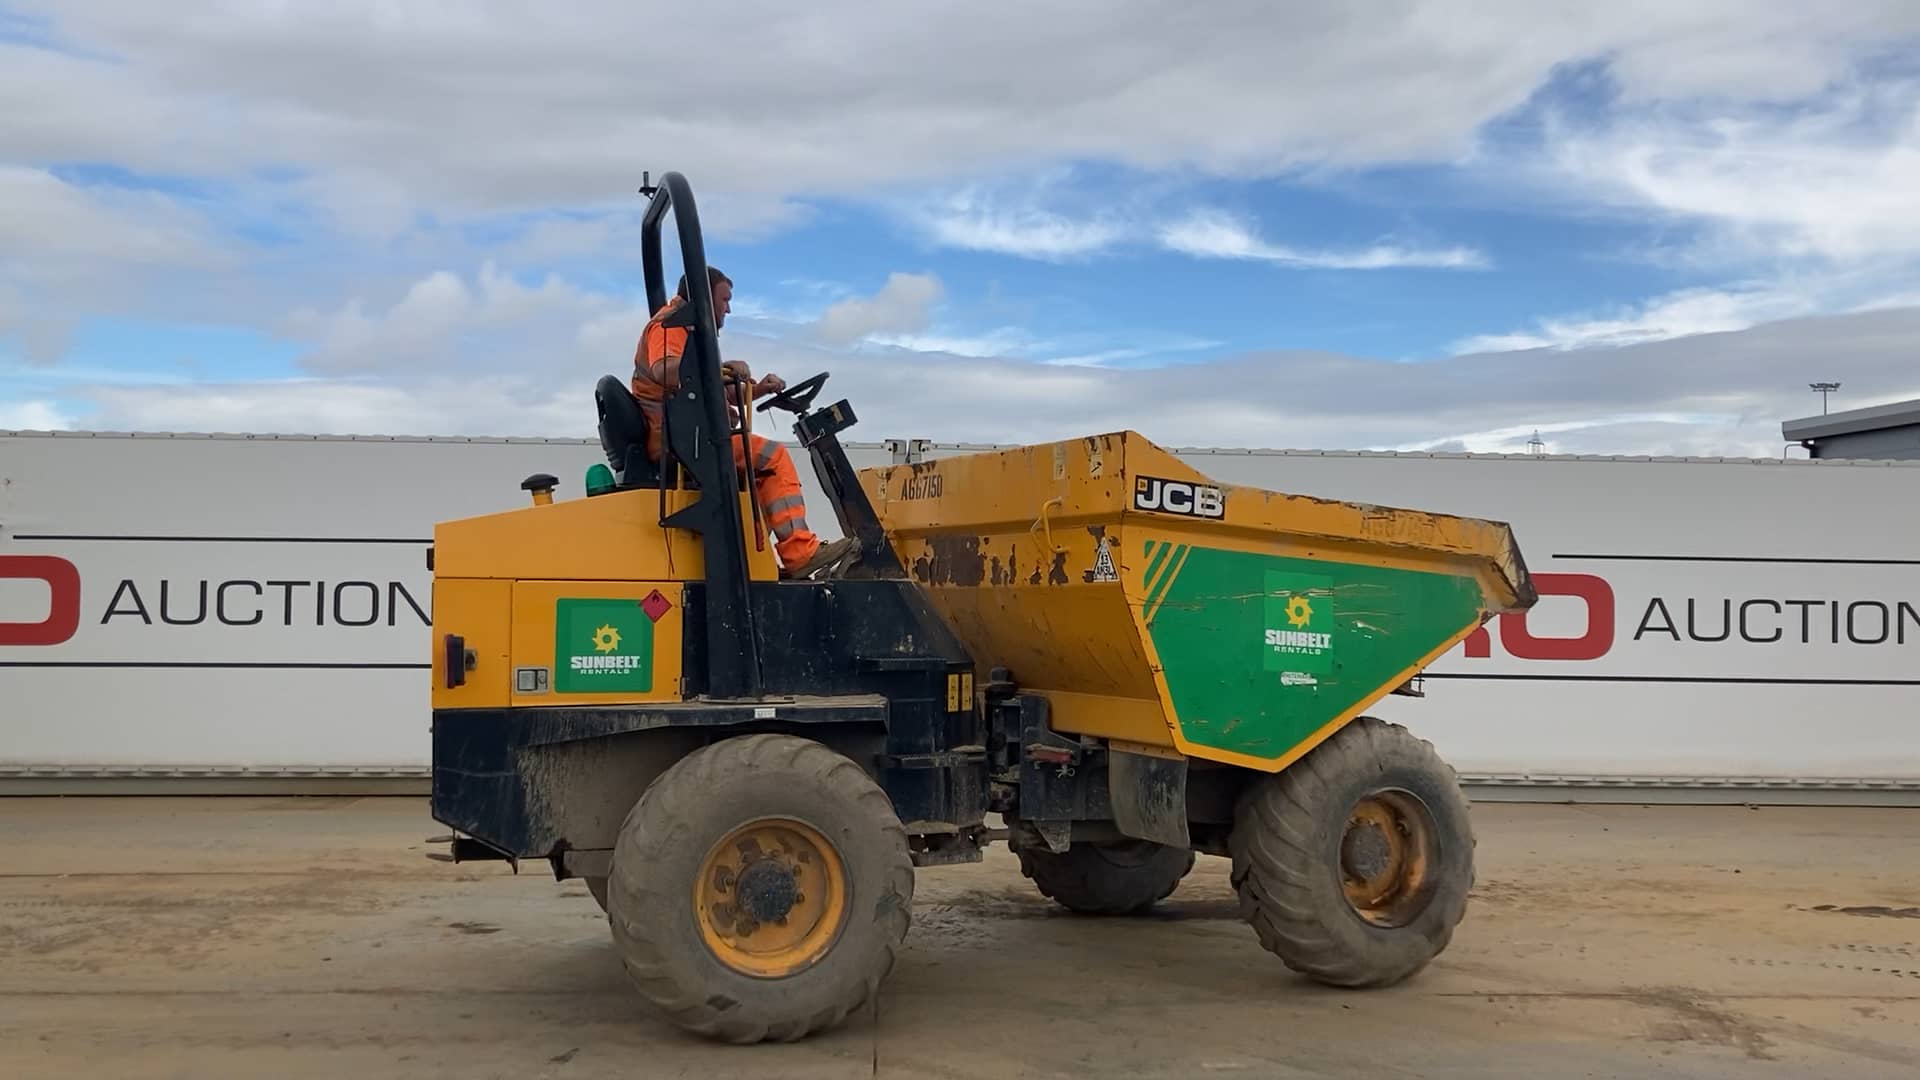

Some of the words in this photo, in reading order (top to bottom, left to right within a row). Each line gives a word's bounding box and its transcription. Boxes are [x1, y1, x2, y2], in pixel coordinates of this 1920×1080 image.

[1136, 480, 1223, 517] JCB
[1265, 629, 1332, 649] SUNBELT
[1273, 645, 1321, 655] RENTALS
[570, 655, 640, 669] SUNBELT
